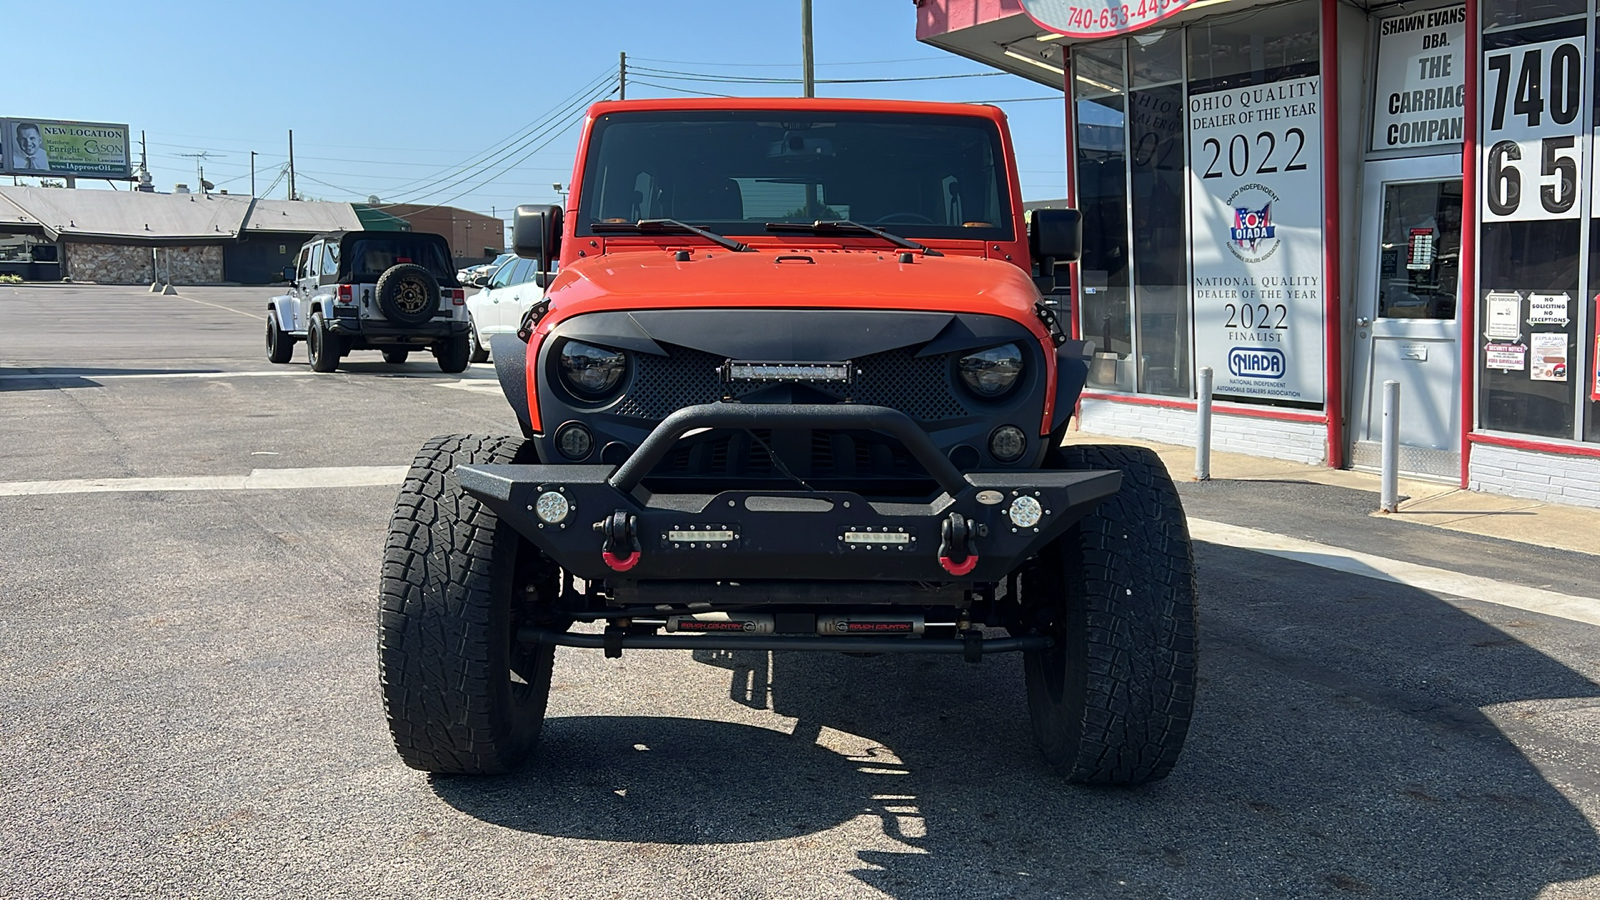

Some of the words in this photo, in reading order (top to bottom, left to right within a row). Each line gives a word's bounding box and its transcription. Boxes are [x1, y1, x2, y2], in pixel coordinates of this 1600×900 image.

[1382, 14, 1425, 36] SHAWN
[1427, 8, 1466, 28] EVANS
[1422, 32, 1450, 50] DBA.
[1419, 54, 1452, 80] THE
[1192, 94, 1232, 112] OHIO
[1240, 80, 1318, 106] QUALITY
[1488, 44, 1580, 131] 740
[1389, 84, 1465, 114] CARRIAG
[1193, 114, 1236, 130] DEALER
[1239, 111, 1254, 124] OF
[1256, 107, 1280, 121] THE
[1284, 102, 1316, 117] YEAR
[45, 127, 67, 135] NEW
[70, 128, 122, 138] LOCATION
[1388, 117, 1464, 145] COMPAN
[49, 146, 80, 154] Enright
[1203, 128, 1307, 179] 2022
[52, 163, 124, 172] www.IApproveOH.com
[1226, 190, 1239, 206] OHIO
[1239, 184, 1280, 202] INDEPENDENT
[1236, 228, 1267, 239] OIADA
[1226, 242, 1244, 261] AUTOMOBILE
[1261, 239, 1280, 261] ASSOCIATION
[1196, 277, 1256, 286] NATIONAL
[1262, 277, 1318, 288] QUALITY
[1197, 290, 1237, 298] DEALER
[1242, 290, 1255, 298] OF
[1260, 290, 1282, 298] THE
[1287, 290, 1317, 299] YEAR
[1225, 303, 1288, 329] 2022
[1229, 332, 1282, 342] FINALIST
[1233, 354, 1279, 372] NIADA
